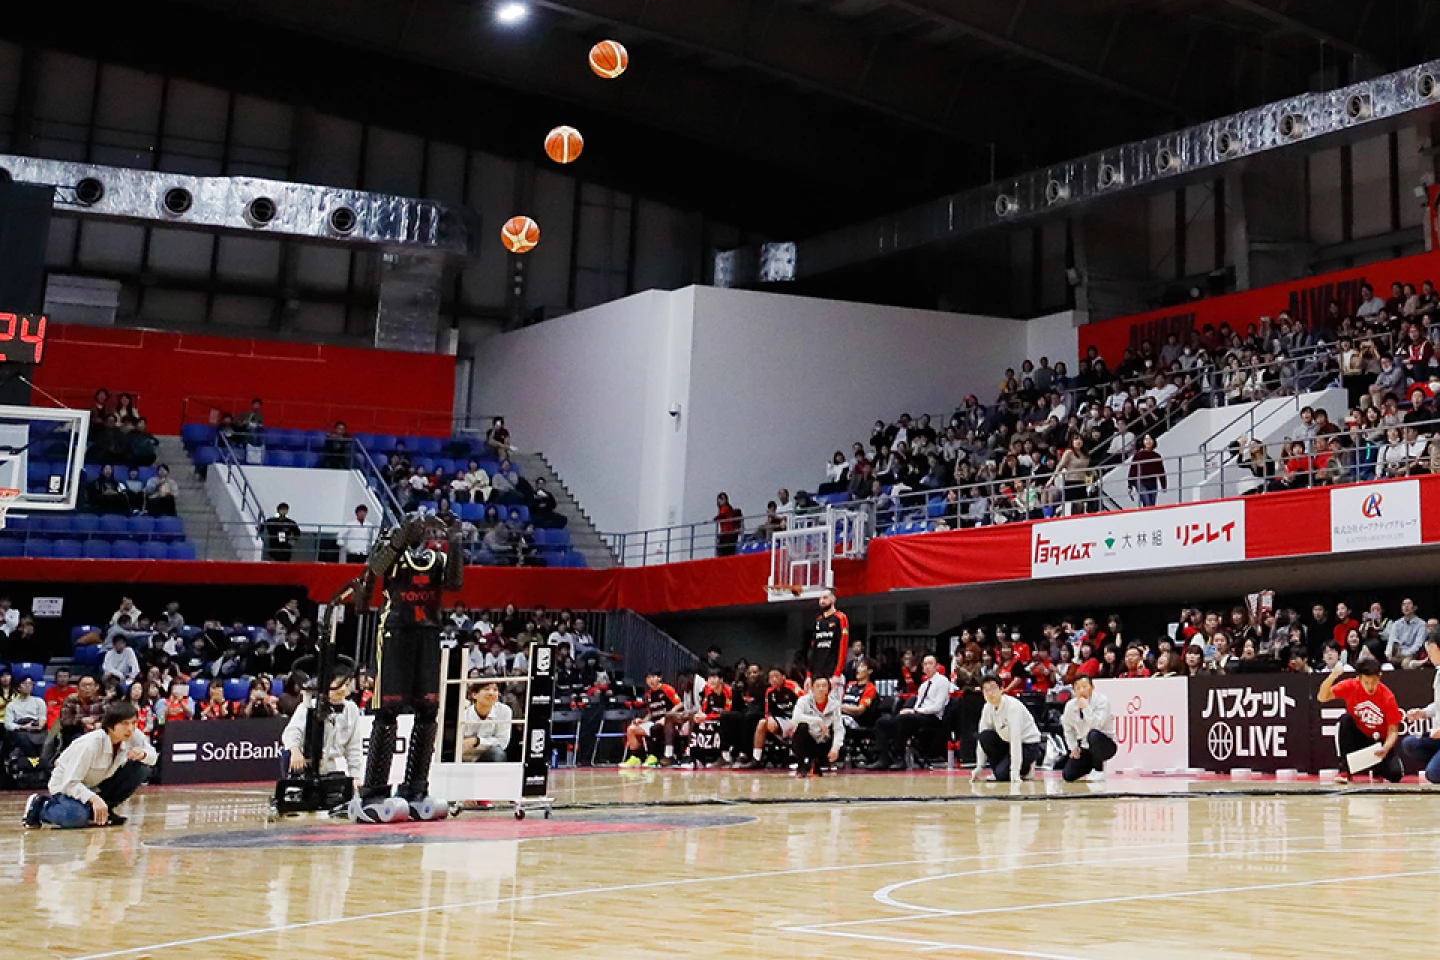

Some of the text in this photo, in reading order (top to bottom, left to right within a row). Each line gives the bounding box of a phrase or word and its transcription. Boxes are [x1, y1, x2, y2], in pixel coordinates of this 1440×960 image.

[1034, 533, 1097, 566] トヨタイムズ
[1176, 520, 1236, 548] リンレイ
[1202, 686, 1296, 719] バスケット
[1114, 708, 1174, 754] UJITSU
[1235, 725, 1288, 757] LIVE
[200, 741, 283, 762] SoftBank
